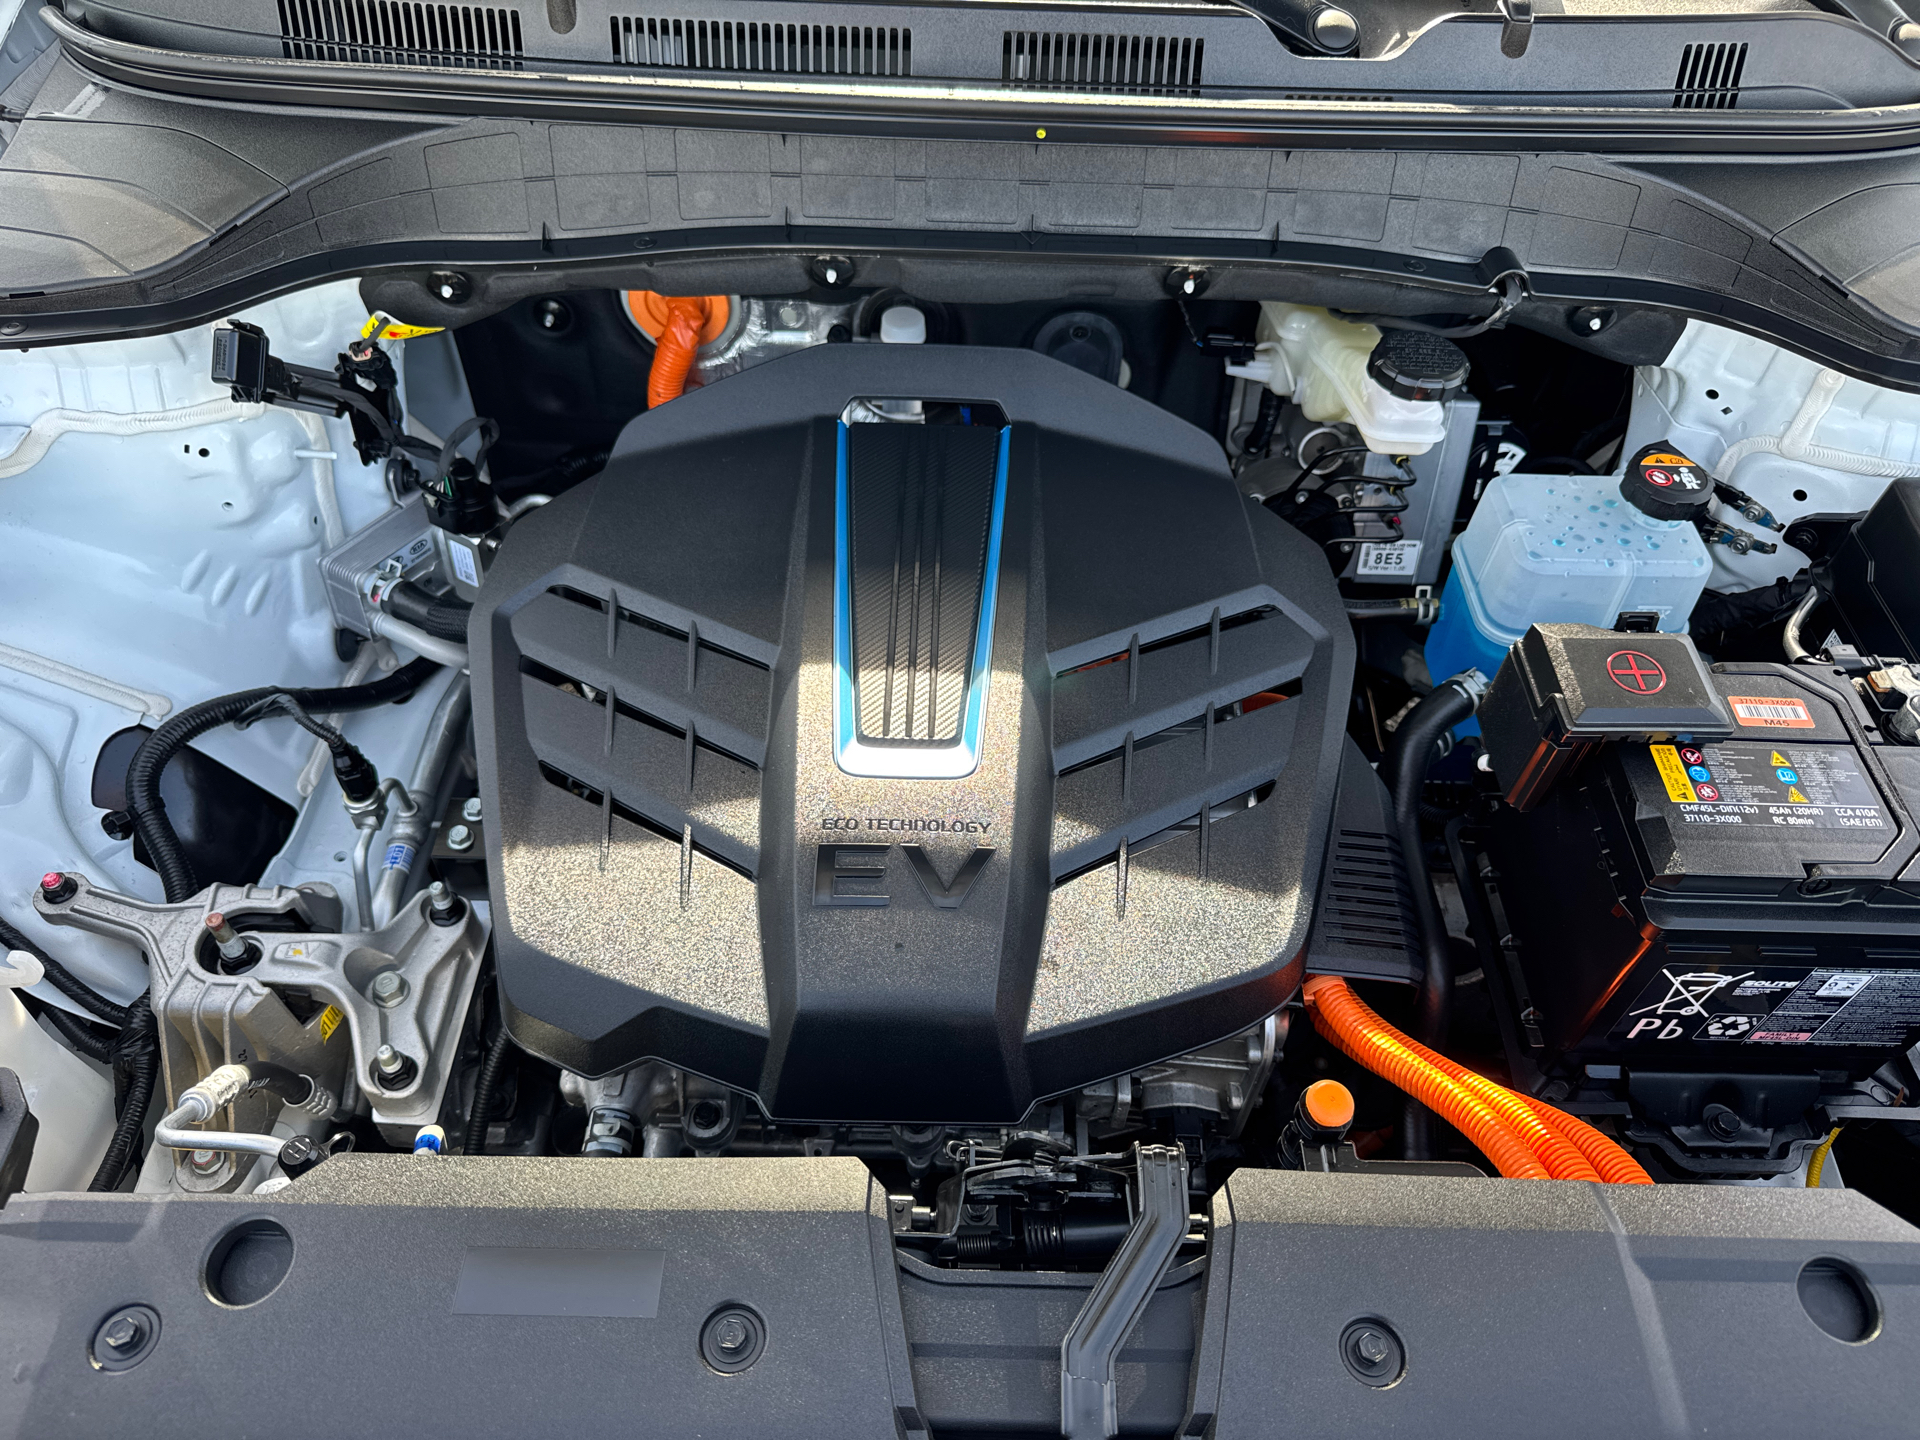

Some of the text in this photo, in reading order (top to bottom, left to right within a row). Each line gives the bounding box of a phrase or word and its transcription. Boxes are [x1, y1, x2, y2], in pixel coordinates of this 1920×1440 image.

[1374, 553, 1404, 565] 8E5
[1764, 719, 1790, 727] M45
[1769, 806, 1824, 816] 45Ah (20HR)
[1834, 808, 1878, 817] CCA 410A
[1684, 814, 1742, 823] 37110-3X000
[1772, 816, 1814, 825] RC 80min
[822, 818, 992, 834] ECO TECHNOLOGY
[813, 843, 996, 908] EV
[1626, 1018, 1684, 1039] Pb
[287, 1141, 307, 1159] H
